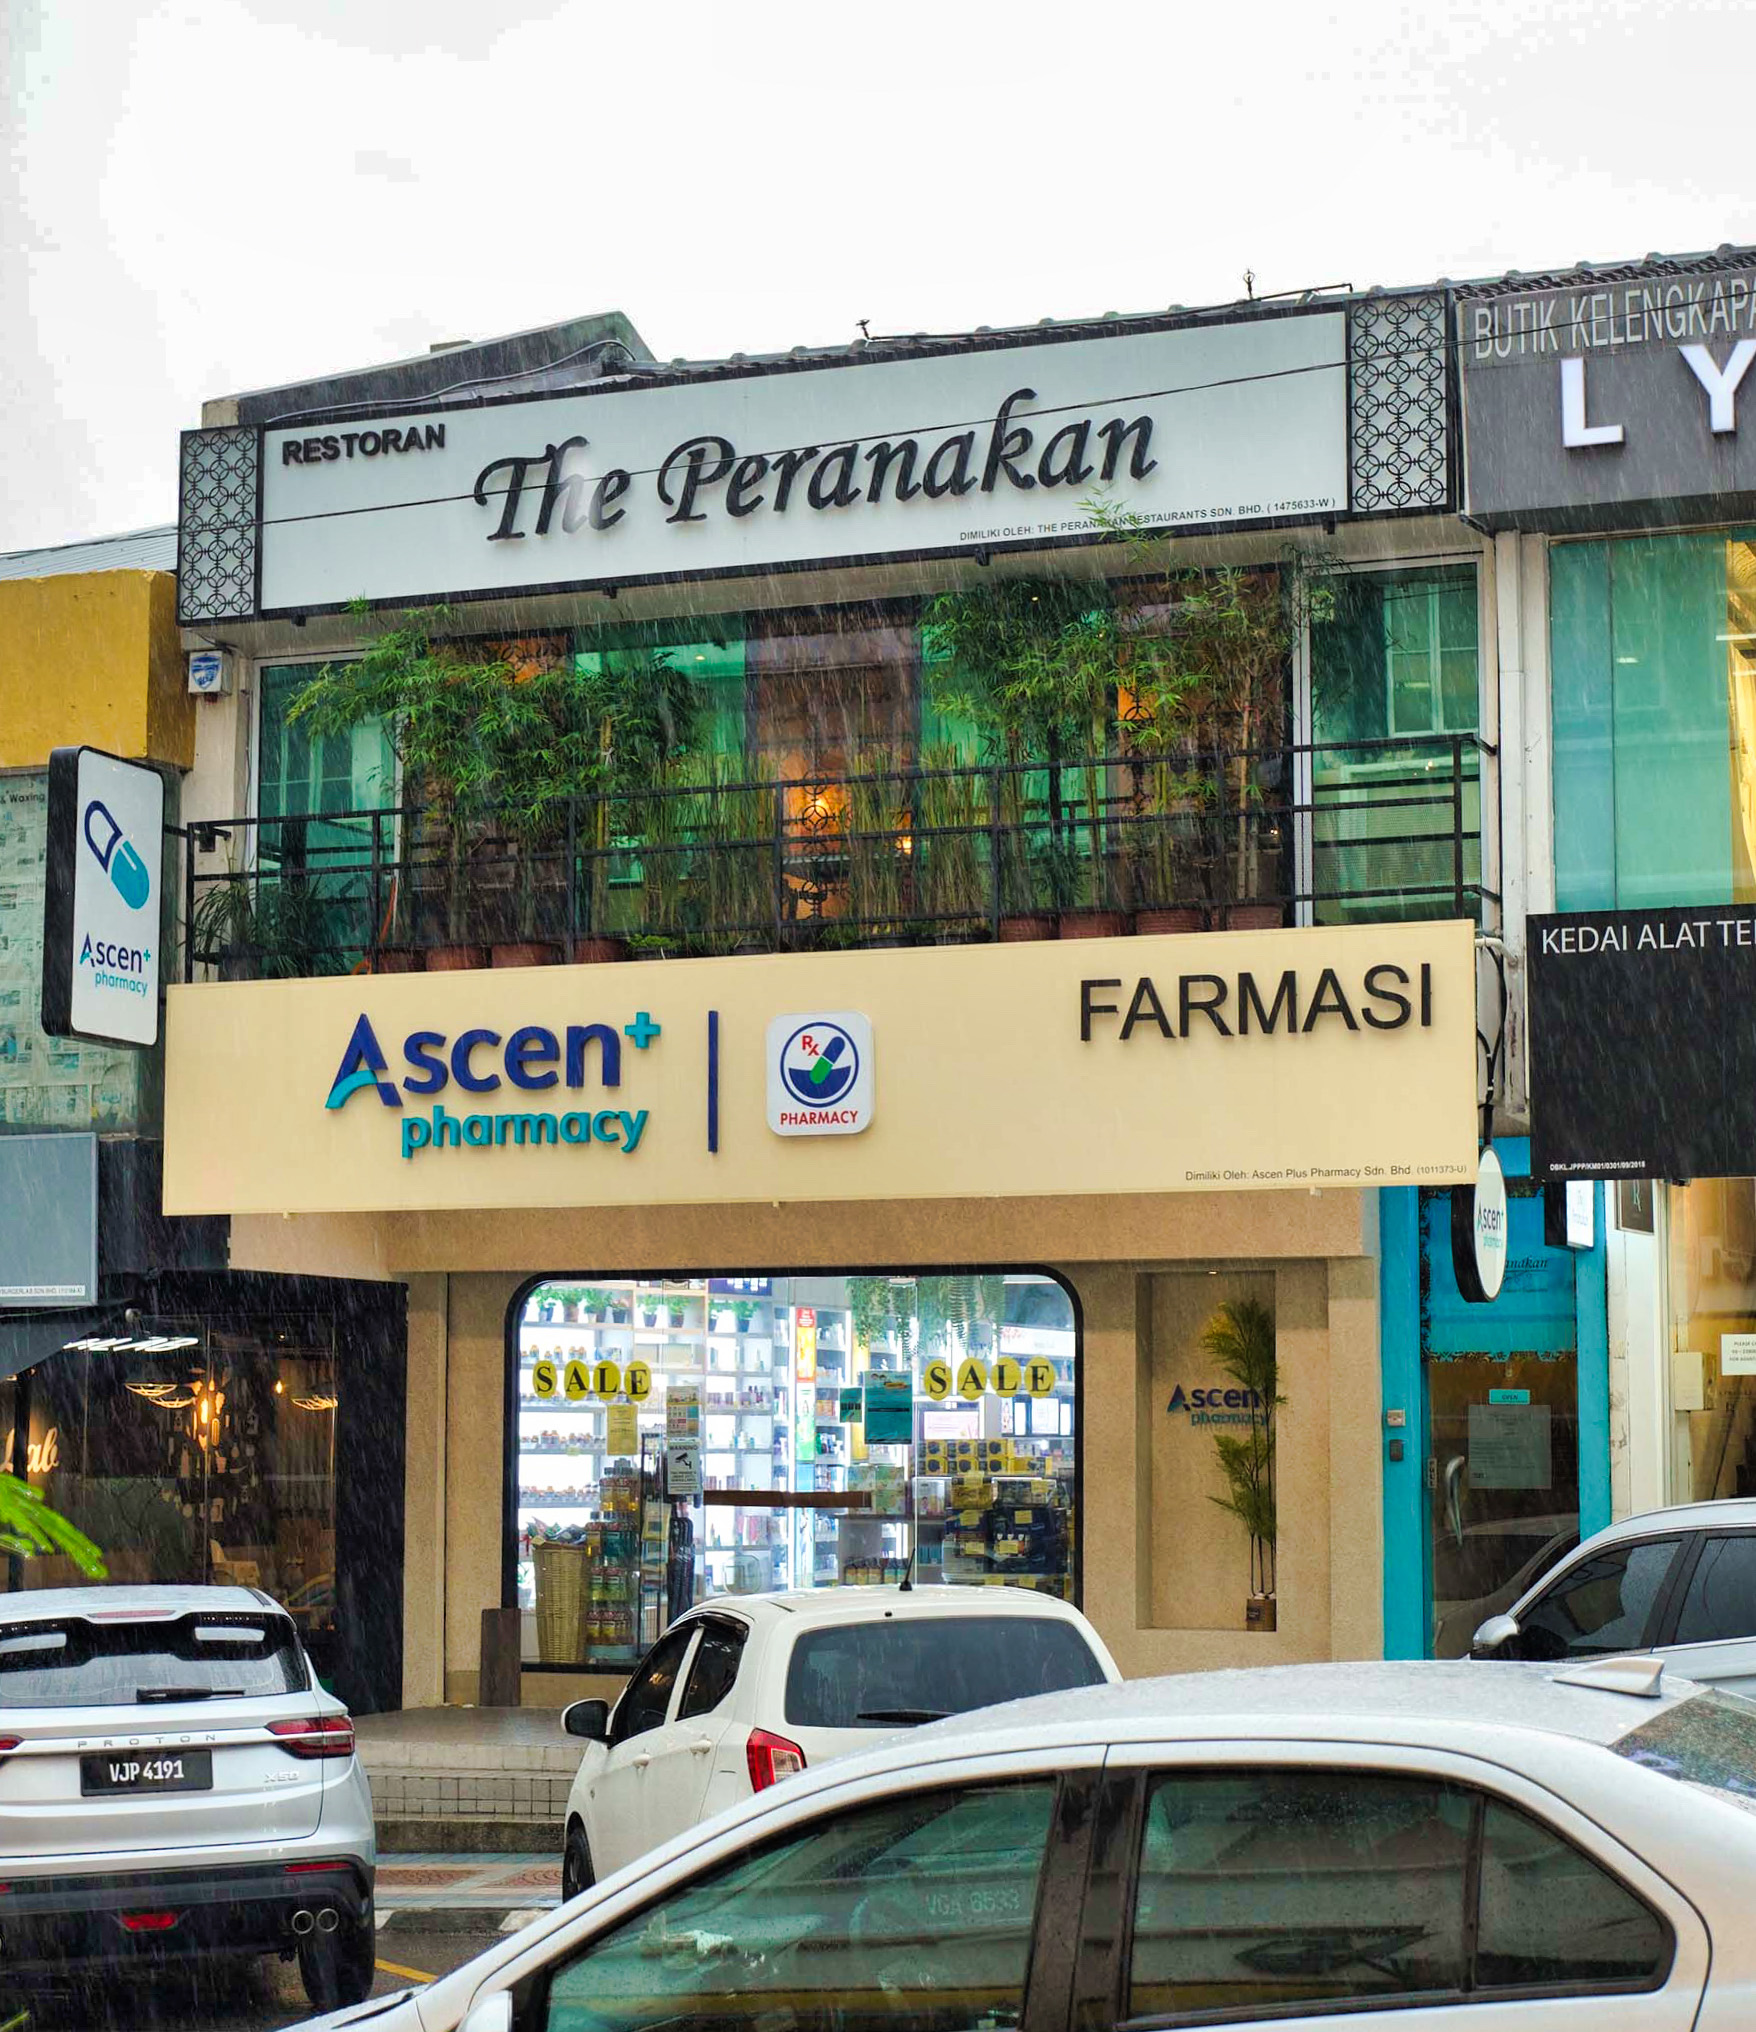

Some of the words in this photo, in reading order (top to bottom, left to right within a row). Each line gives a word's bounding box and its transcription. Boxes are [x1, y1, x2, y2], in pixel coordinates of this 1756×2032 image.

[1475, 299, 1558, 360] BUTIK
[282, 423, 445, 466] RESTORAN
[474, 435, 632, 542] The
[657, 388, 1158, 523] Peranakan
[960, 529, 1000, 541] DIMILIKI
[1003, 526, 1034, 537] OLEH:
[1037, 523, 1057, 534] THE
[1238, 505, 1264, 516] BHD.
[1542, 924, 1628, 954] KEDAI
[1637, 921, 1711, 950] ALAT
[1716, 918, 1756, 947] TE
[95, 969, 148, 998] pharmacy
[1080, 962, 1432, 1042] FARMASI
[402, 1104, 649, 1159] pharmacy
[780, 1110, 858, 1125] PHARMACY
[1185, 1170, 1221, 1181] Dimiliki
[1223, 1170, 1249, 1180] Oleh:
[1252, 1169, 1283, 1179] Ascen
[1286, 1168, 1308, 1178] Plus
[1311, 1167, 1361, 1178] Pharmacy
[1416, 1164, 1467, 1175] (1011373-U)
[536, 1366, 649, 1395] SALE
[930, 1364, 1052, 1394] SALE
[77, 1734, 216, 1748] PROTON
[109, 1762, 140, 1783] VJP
[142, 1759, 185, 1780] 4191
